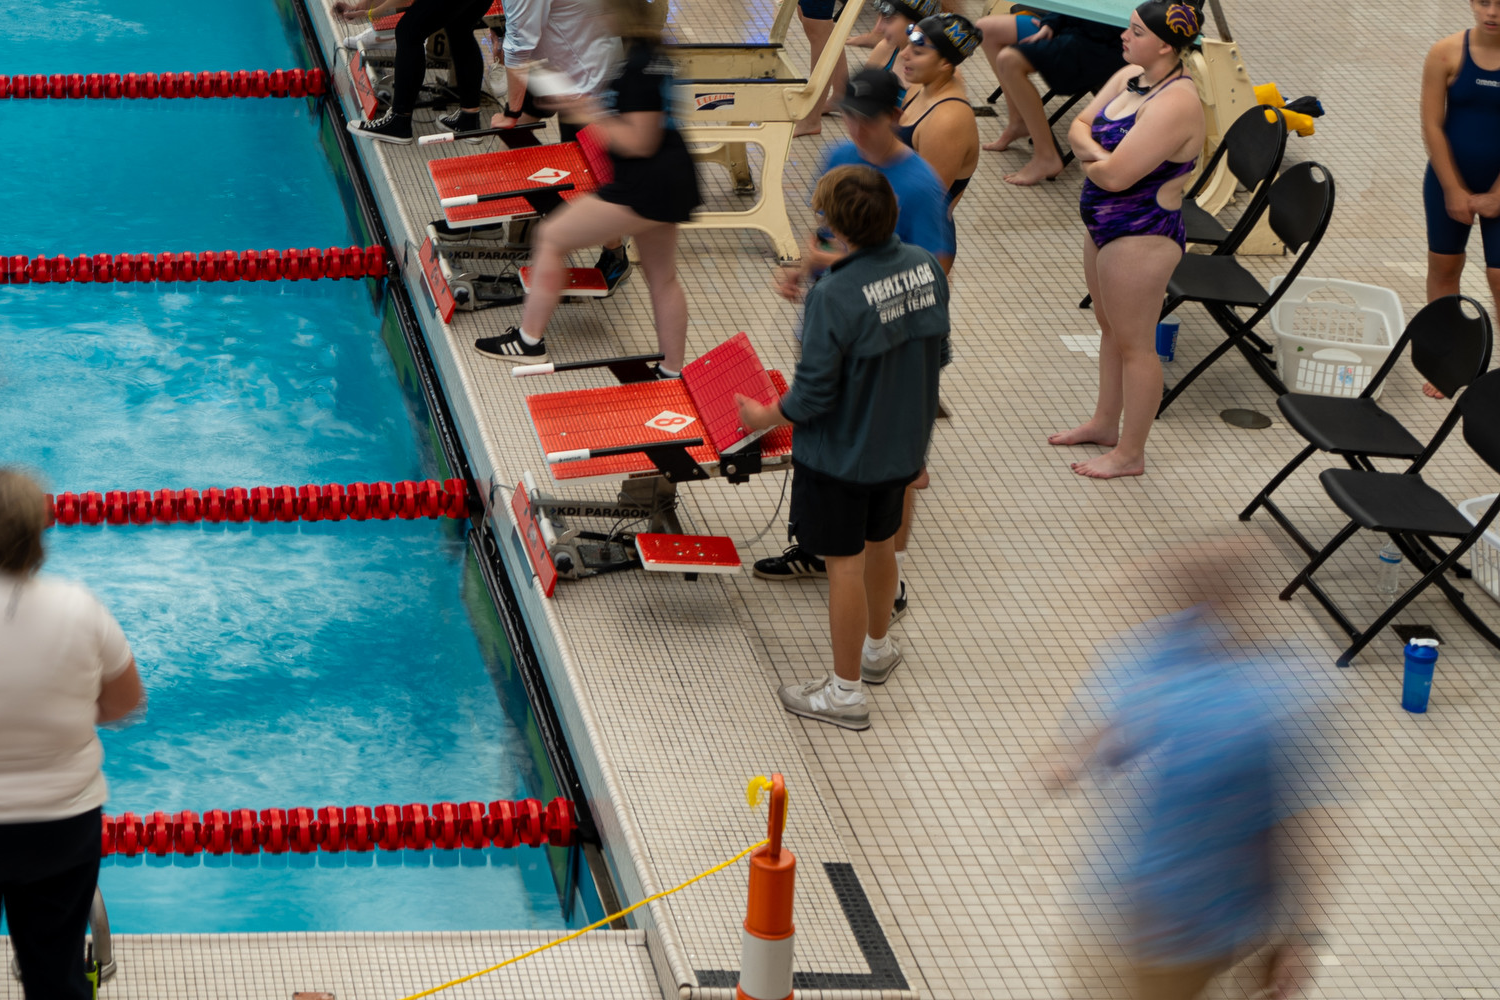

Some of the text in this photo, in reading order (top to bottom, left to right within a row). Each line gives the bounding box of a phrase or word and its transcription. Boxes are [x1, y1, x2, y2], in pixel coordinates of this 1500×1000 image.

[433, 33, 446, 57] 6
[454, 251, 475, 259] KDI
[861, 262, 936, 307] HERITAGE
[879, 303, 906, 324] STATE
[907, 293, 937, 313] TEAM
[653, 417, 687, 427] 8
[556, 506, 650, 519] KDI PARAGON
